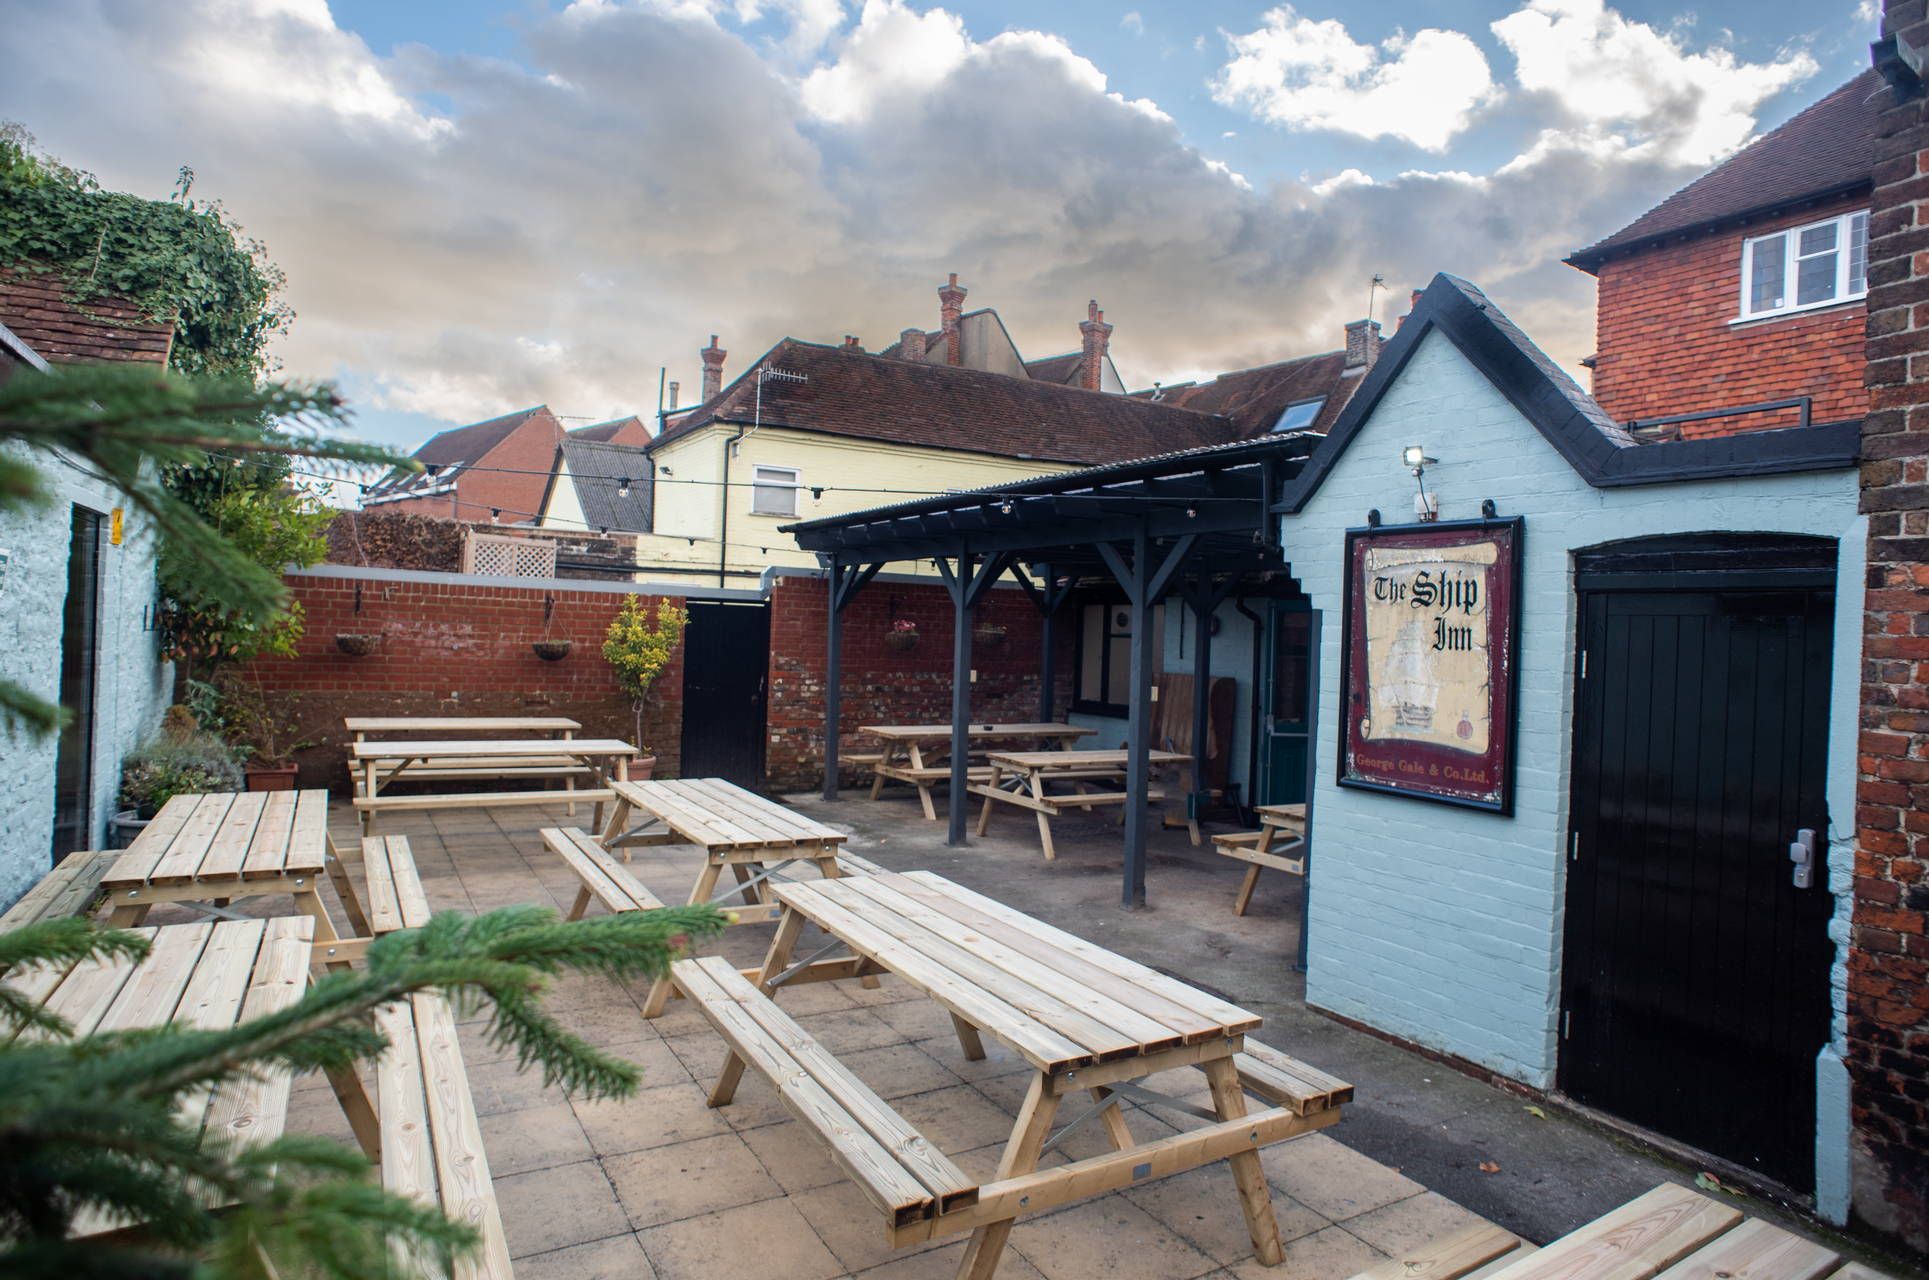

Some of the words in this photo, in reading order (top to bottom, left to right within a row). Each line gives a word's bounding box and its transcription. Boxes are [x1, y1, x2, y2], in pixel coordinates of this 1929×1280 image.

[1375, 576, 1407, 605] The
[1410, 570, 1478, 616] Ship
[1432, 616, 1472, 651] Inn
[1356, 753, 1395, 771] George
[1398, 760, 1425, 775] Gale
[1429, 763, 1440, 776] &
